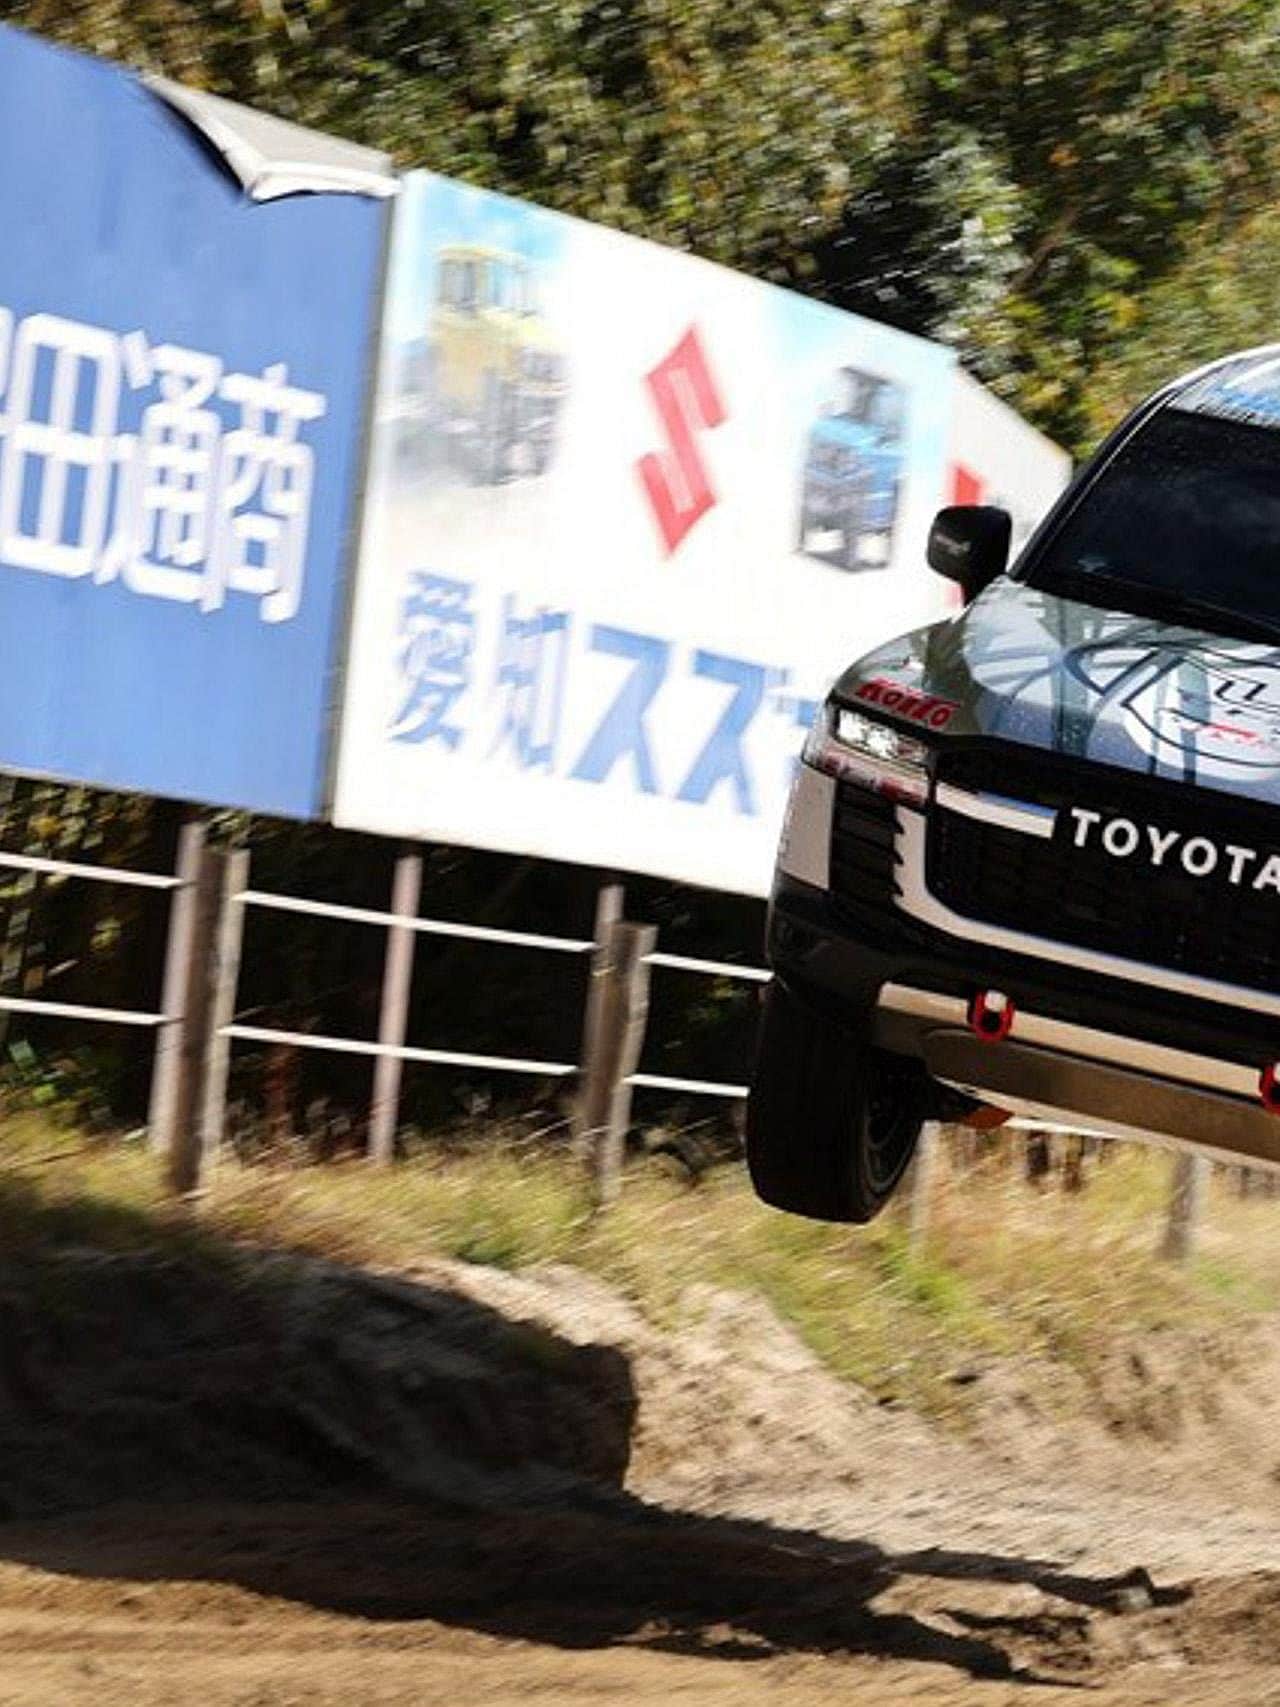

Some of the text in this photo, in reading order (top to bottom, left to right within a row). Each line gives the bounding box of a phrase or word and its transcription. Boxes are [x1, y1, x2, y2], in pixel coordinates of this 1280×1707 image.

[0, 305, 327, 623] 田通商
[384, 571, 821, 817] 愛知スズ
